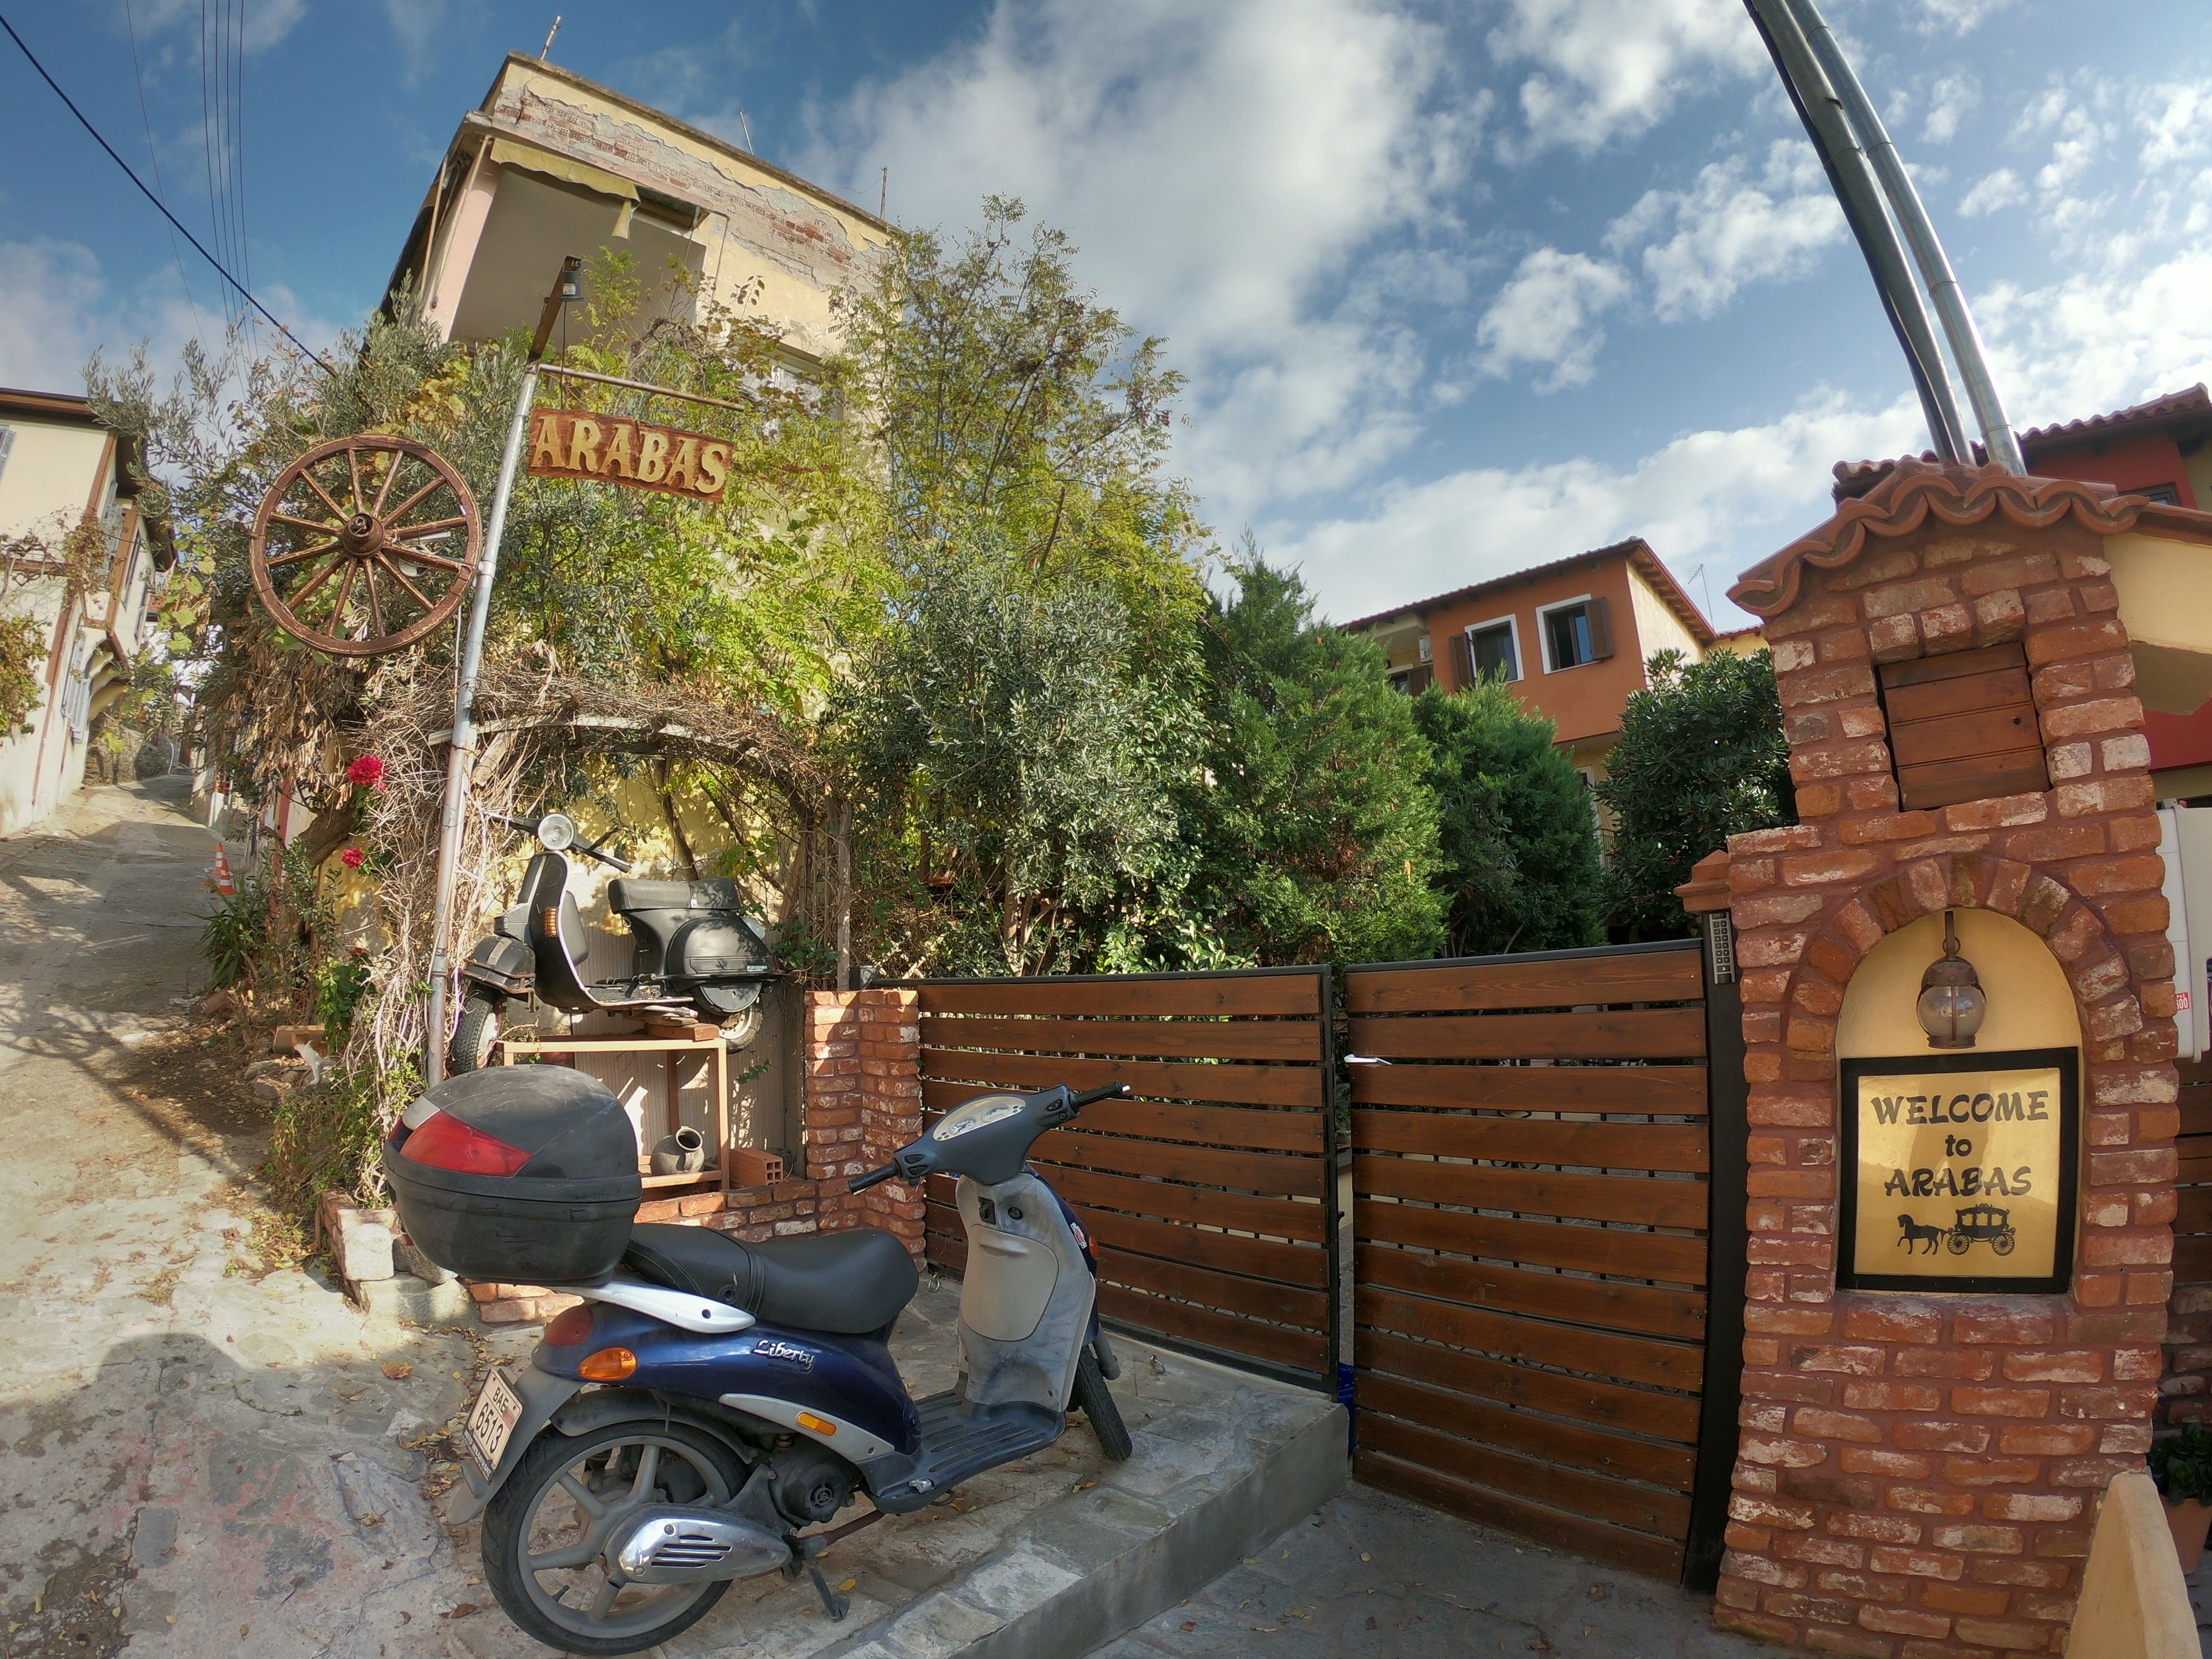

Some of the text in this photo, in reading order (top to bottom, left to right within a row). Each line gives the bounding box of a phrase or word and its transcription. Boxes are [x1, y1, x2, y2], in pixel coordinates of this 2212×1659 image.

[530, 417, 729, 494] ARABAS
[1870, 1090, 2048, 1124] WELCOME
[1945, 1134, 1972, 1157] to
[1884, 1166, 2032, 1197] ARABAS
[753, 1339, 815, 1369] Liberty
[476, 1402, 503, 1454] 6513
